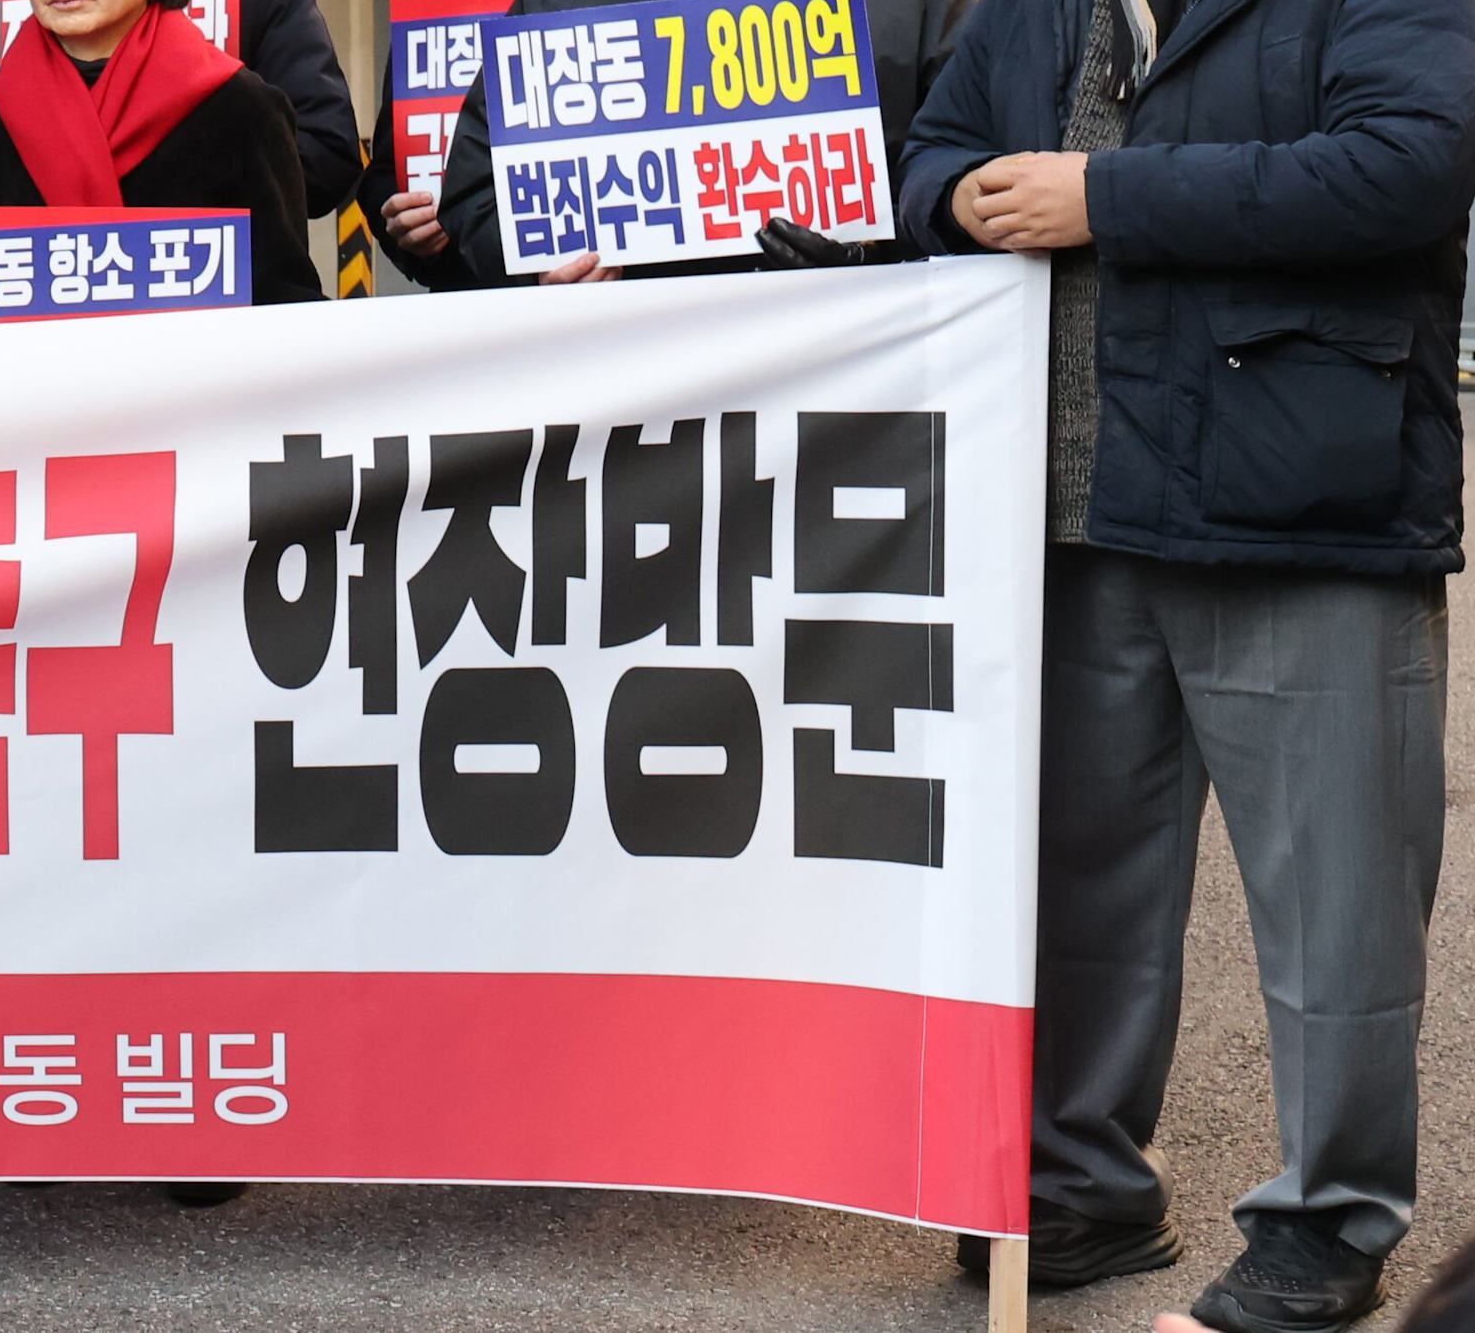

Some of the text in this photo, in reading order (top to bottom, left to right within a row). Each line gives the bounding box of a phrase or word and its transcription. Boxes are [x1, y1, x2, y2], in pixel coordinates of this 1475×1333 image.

[495, 19, 647, 131] 대장동
[506, 148, 685, 258] 범죄수익
[693, 128, 875, 241] 환수하라
[49, 232, 134, 305] 항소
[148, 225, 235, 298] 포기
[243, 410, 954, 869] 현장방문
[114, 1032, 292, 1126] 빌딩
